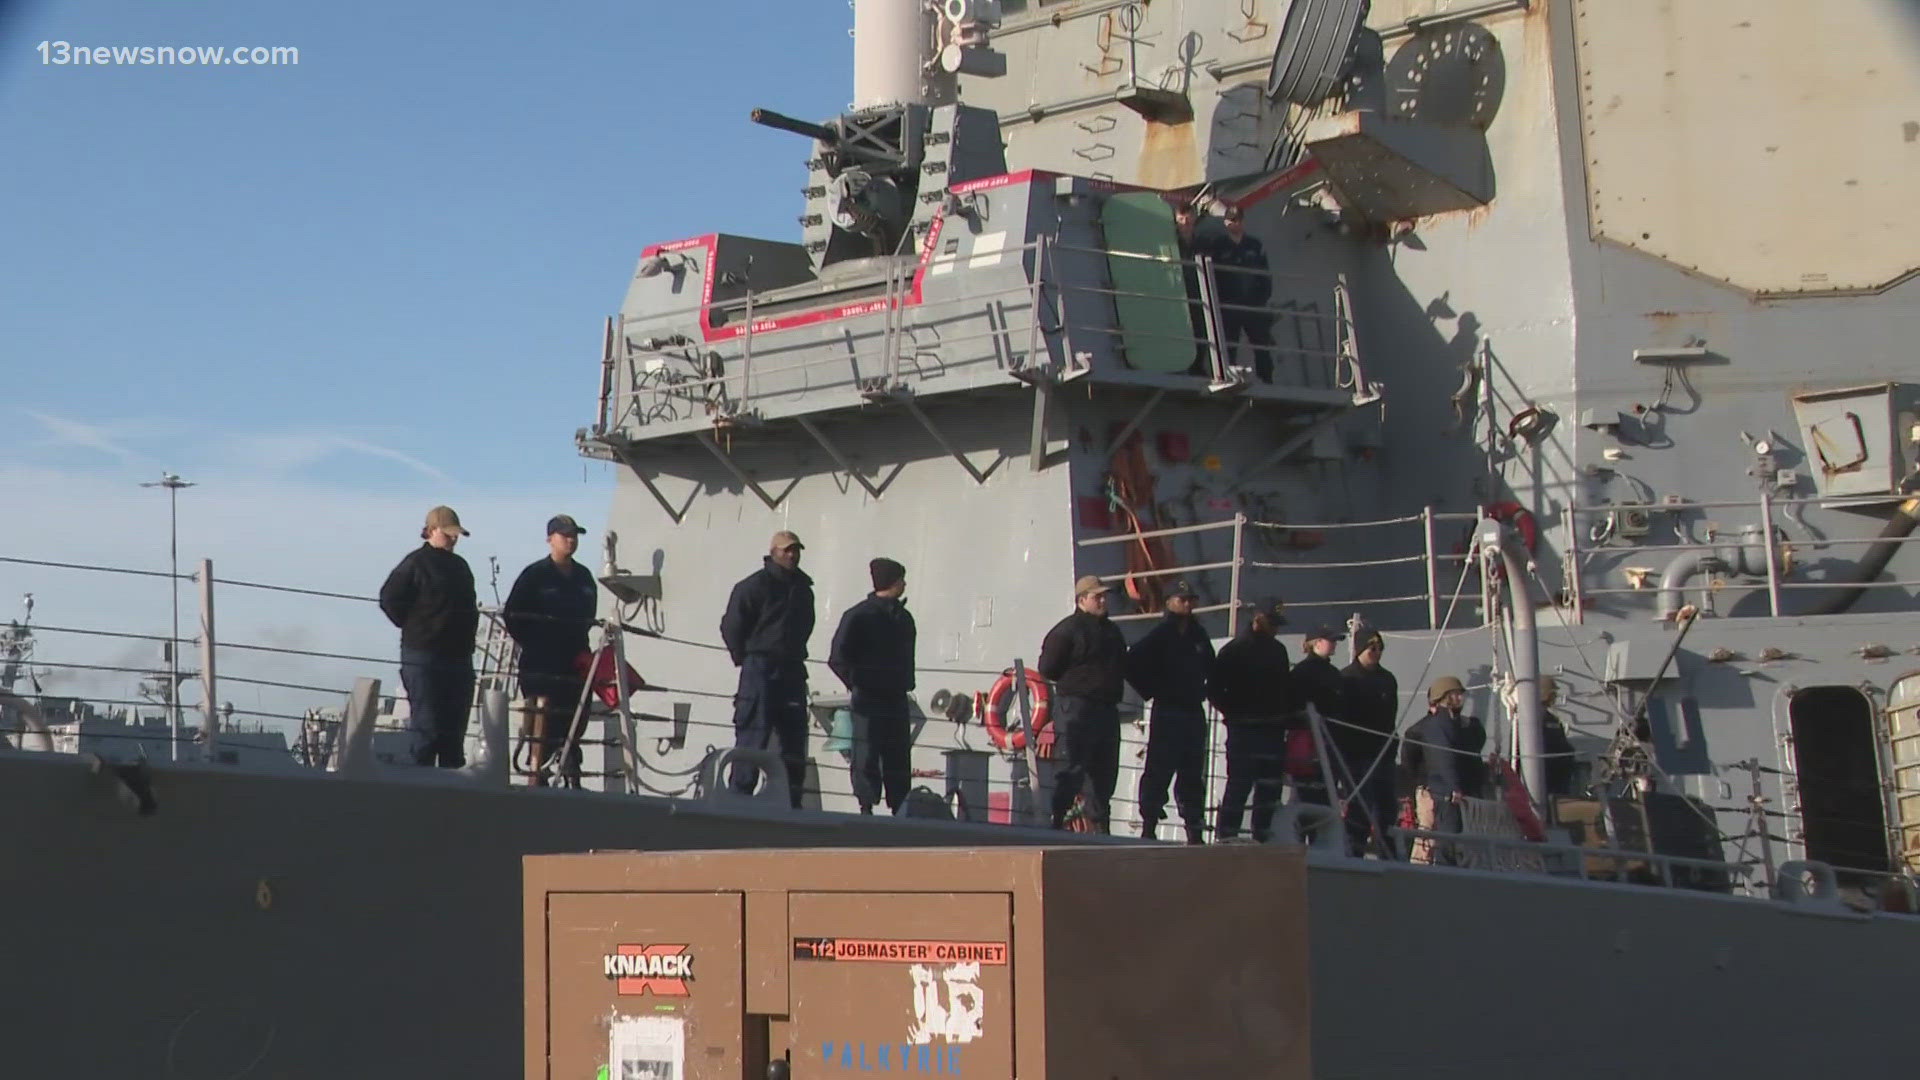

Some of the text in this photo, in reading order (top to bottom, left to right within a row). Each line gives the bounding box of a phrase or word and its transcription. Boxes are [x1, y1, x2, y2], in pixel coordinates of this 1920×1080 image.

[936, 945, 1004, 961] CABINET
[604, 954, 694, 979] KNAACK
[822, 1040, 962, 1075] VALKYRIE
